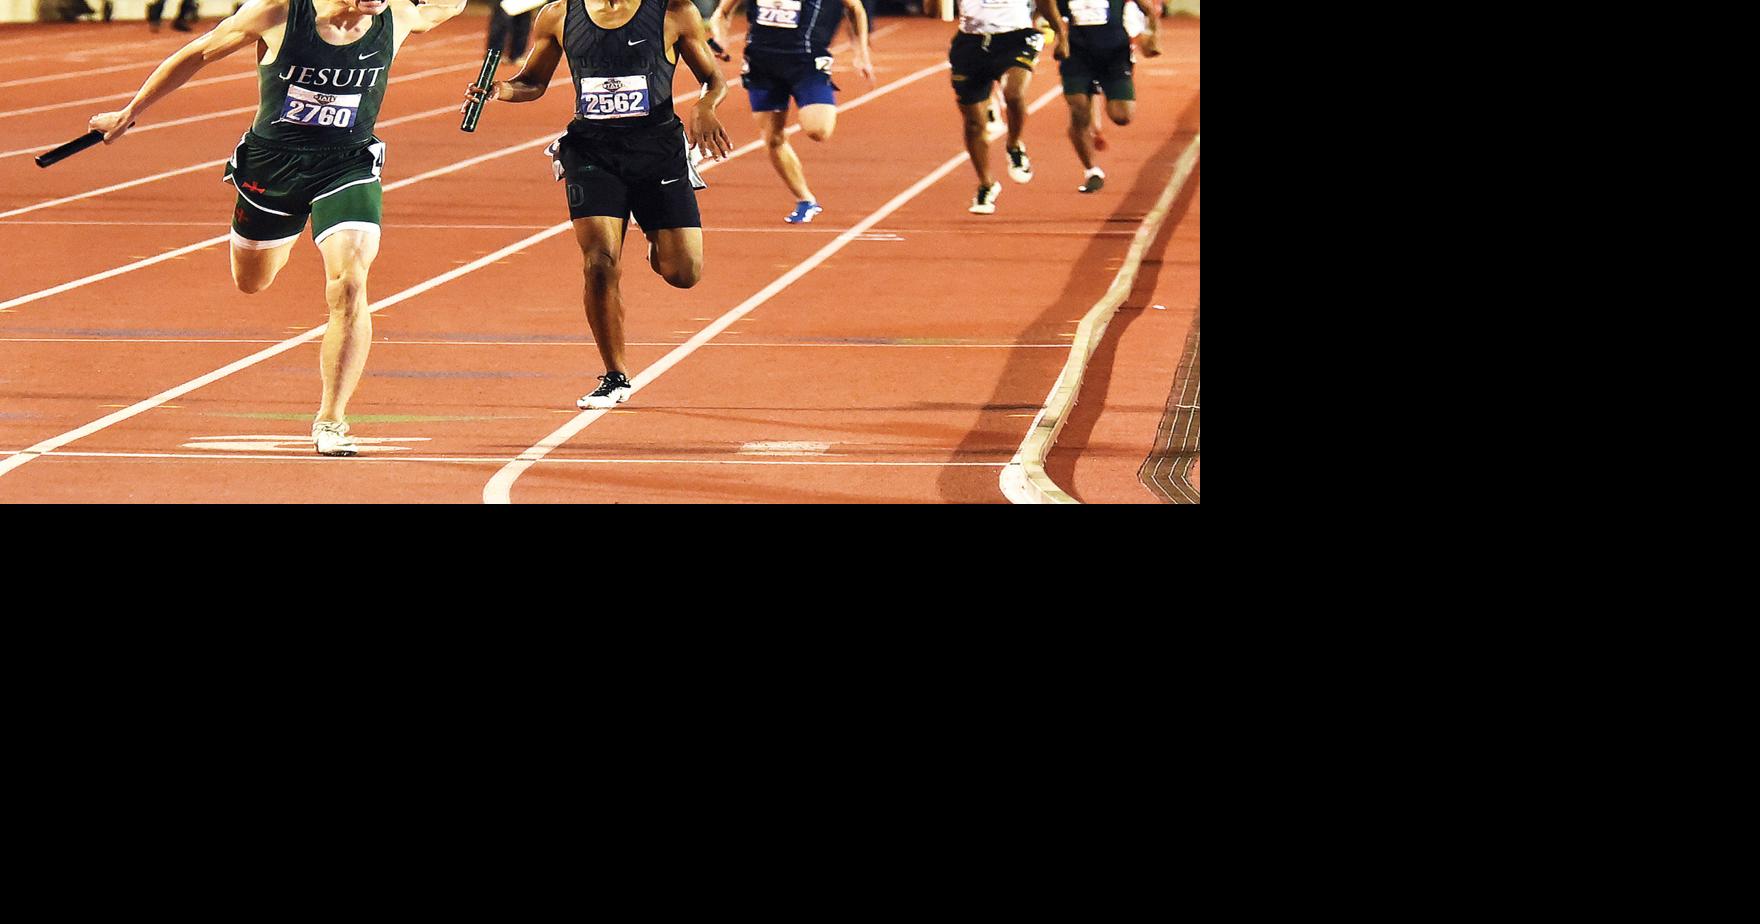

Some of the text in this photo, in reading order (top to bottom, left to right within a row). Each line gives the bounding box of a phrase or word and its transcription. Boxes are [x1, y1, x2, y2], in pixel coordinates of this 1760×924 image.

[279, 65, 385, 88] JESUIT
[286, 100, 352, 128] 2760
[585, 91, 645, 114] 2562
